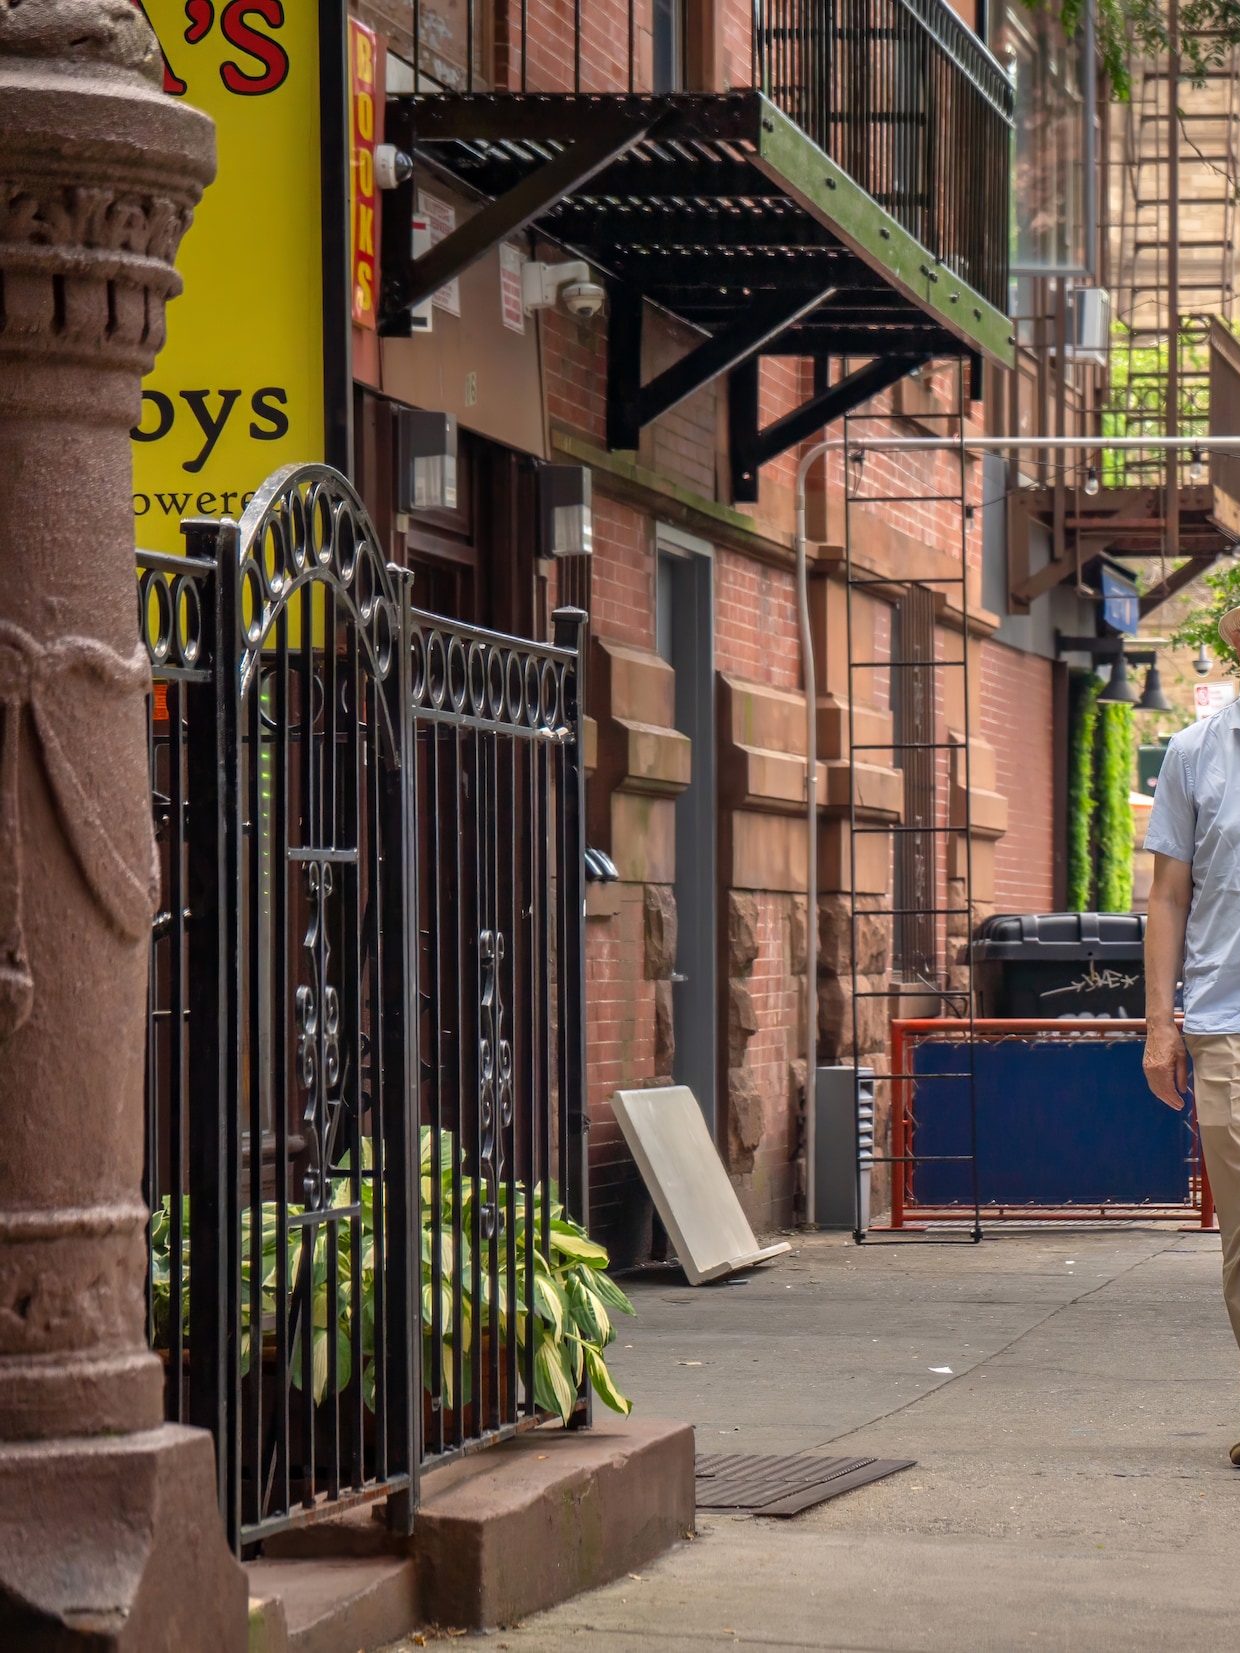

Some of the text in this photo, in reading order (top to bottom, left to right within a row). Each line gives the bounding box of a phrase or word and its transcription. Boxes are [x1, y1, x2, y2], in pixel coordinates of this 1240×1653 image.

[131, 0, 289, 96] 'S
[355, 31, 375, 312] BOOKS
[130, 387, 289, 473] oys
[133, 491, 281, 516] owere
